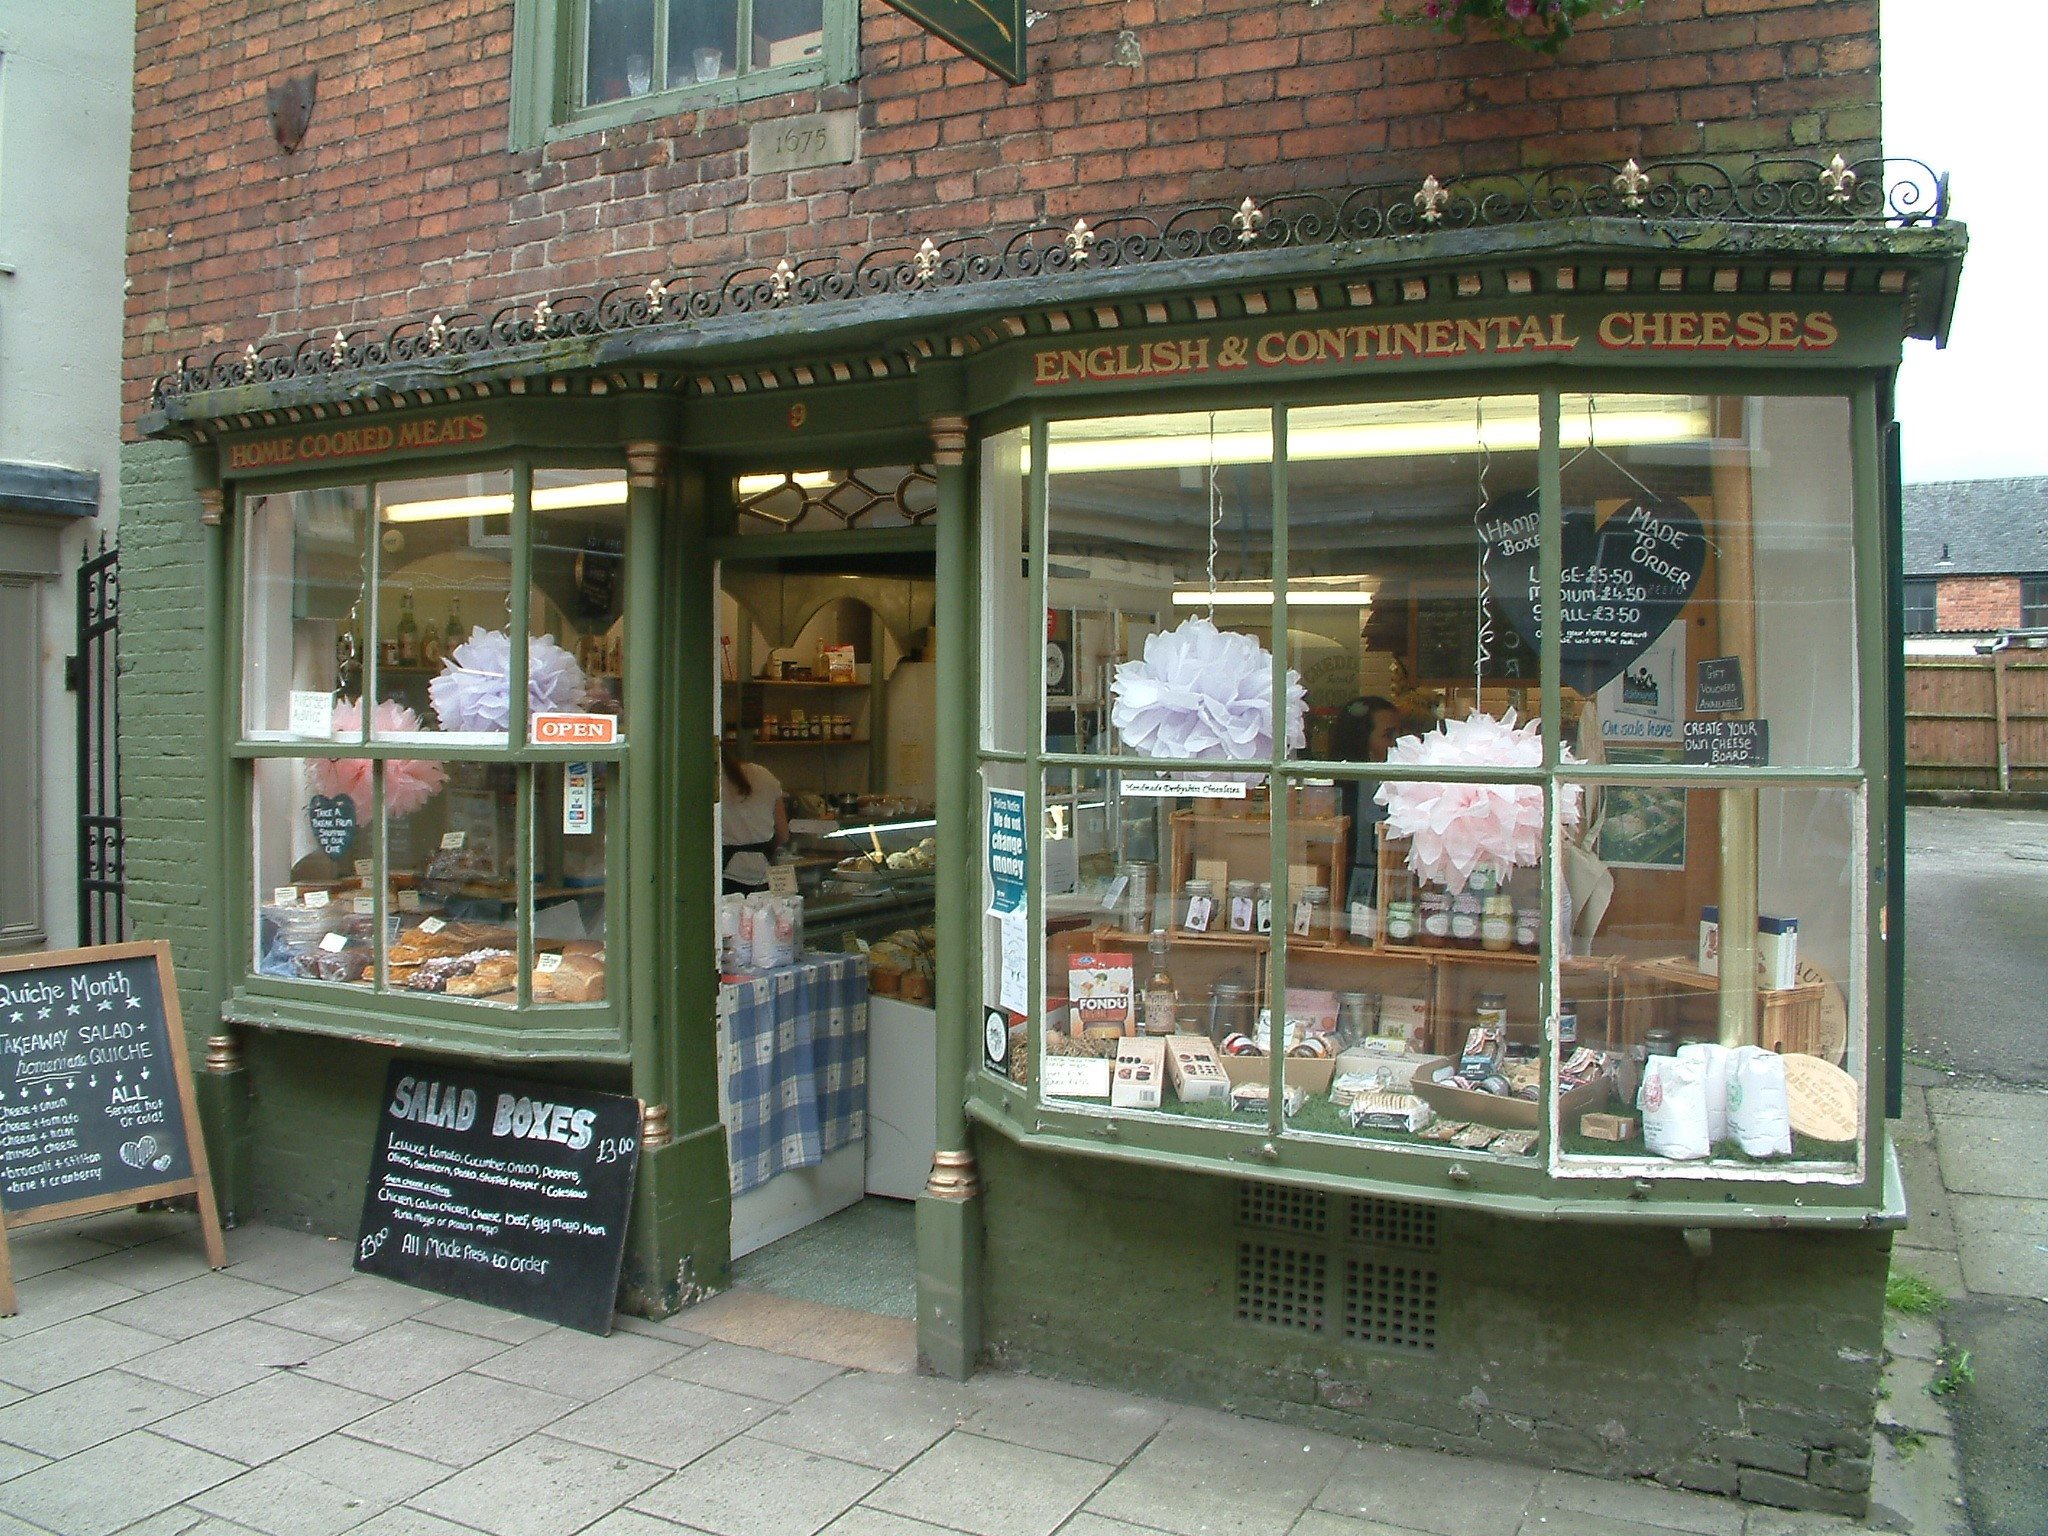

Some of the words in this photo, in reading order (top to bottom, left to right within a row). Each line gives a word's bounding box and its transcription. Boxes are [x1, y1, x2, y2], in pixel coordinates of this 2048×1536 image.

[775, 128, 828, 154] 1675
[1034, 338, 1209, 386] ENGLISH
[1217, 335, 1248, 370] &
[1256, 312, 1580, 366] CONTINENTAL
[1597, 312, 1838, 351] CHEESES
[229, 438, 294, 469] HOME
[298, 426, 393, 460] COOKED
[397, 414, 488, 448] MEATS
[1628, 506, 1688, 549] MADE
[1635, 529, 1656, 549] TO
[1631, 546, 1691, 589] ORDER
[542, 722, 604, 737] OPEN
[1621, 720, 1644, 736] sale
[1648, 720, 1673, 737] here
[1684, 722, 1722, 736] CREATE
[1727, 721, 1757, 736] YOUR
[993, 812, 1003, 827] We
[1004, 814, 1011, 829] do
[992, 830, 1023, 856] change
[992, 855, 1024, 880] money
[0, 982, 65, 1008] Quiche
[71, 971, 130, 1001] Month
[78, 1022, 133, 1044] SALAD
[15, 1054, 87, 1076] homemade
[89, 1041, 153, 1065] QUICHE
[112, 1084, 149, 1104] ALL
[144, 1098, 163, 1111] hot
[389, 1076, 477, 1131] SALAD
[492, 1093, 597, 1150] BOXES
[49, 1167, 102, 1187] cranberry
[401, 1233, 420, 1256] All
[492, 1253, 508, 1269] to
